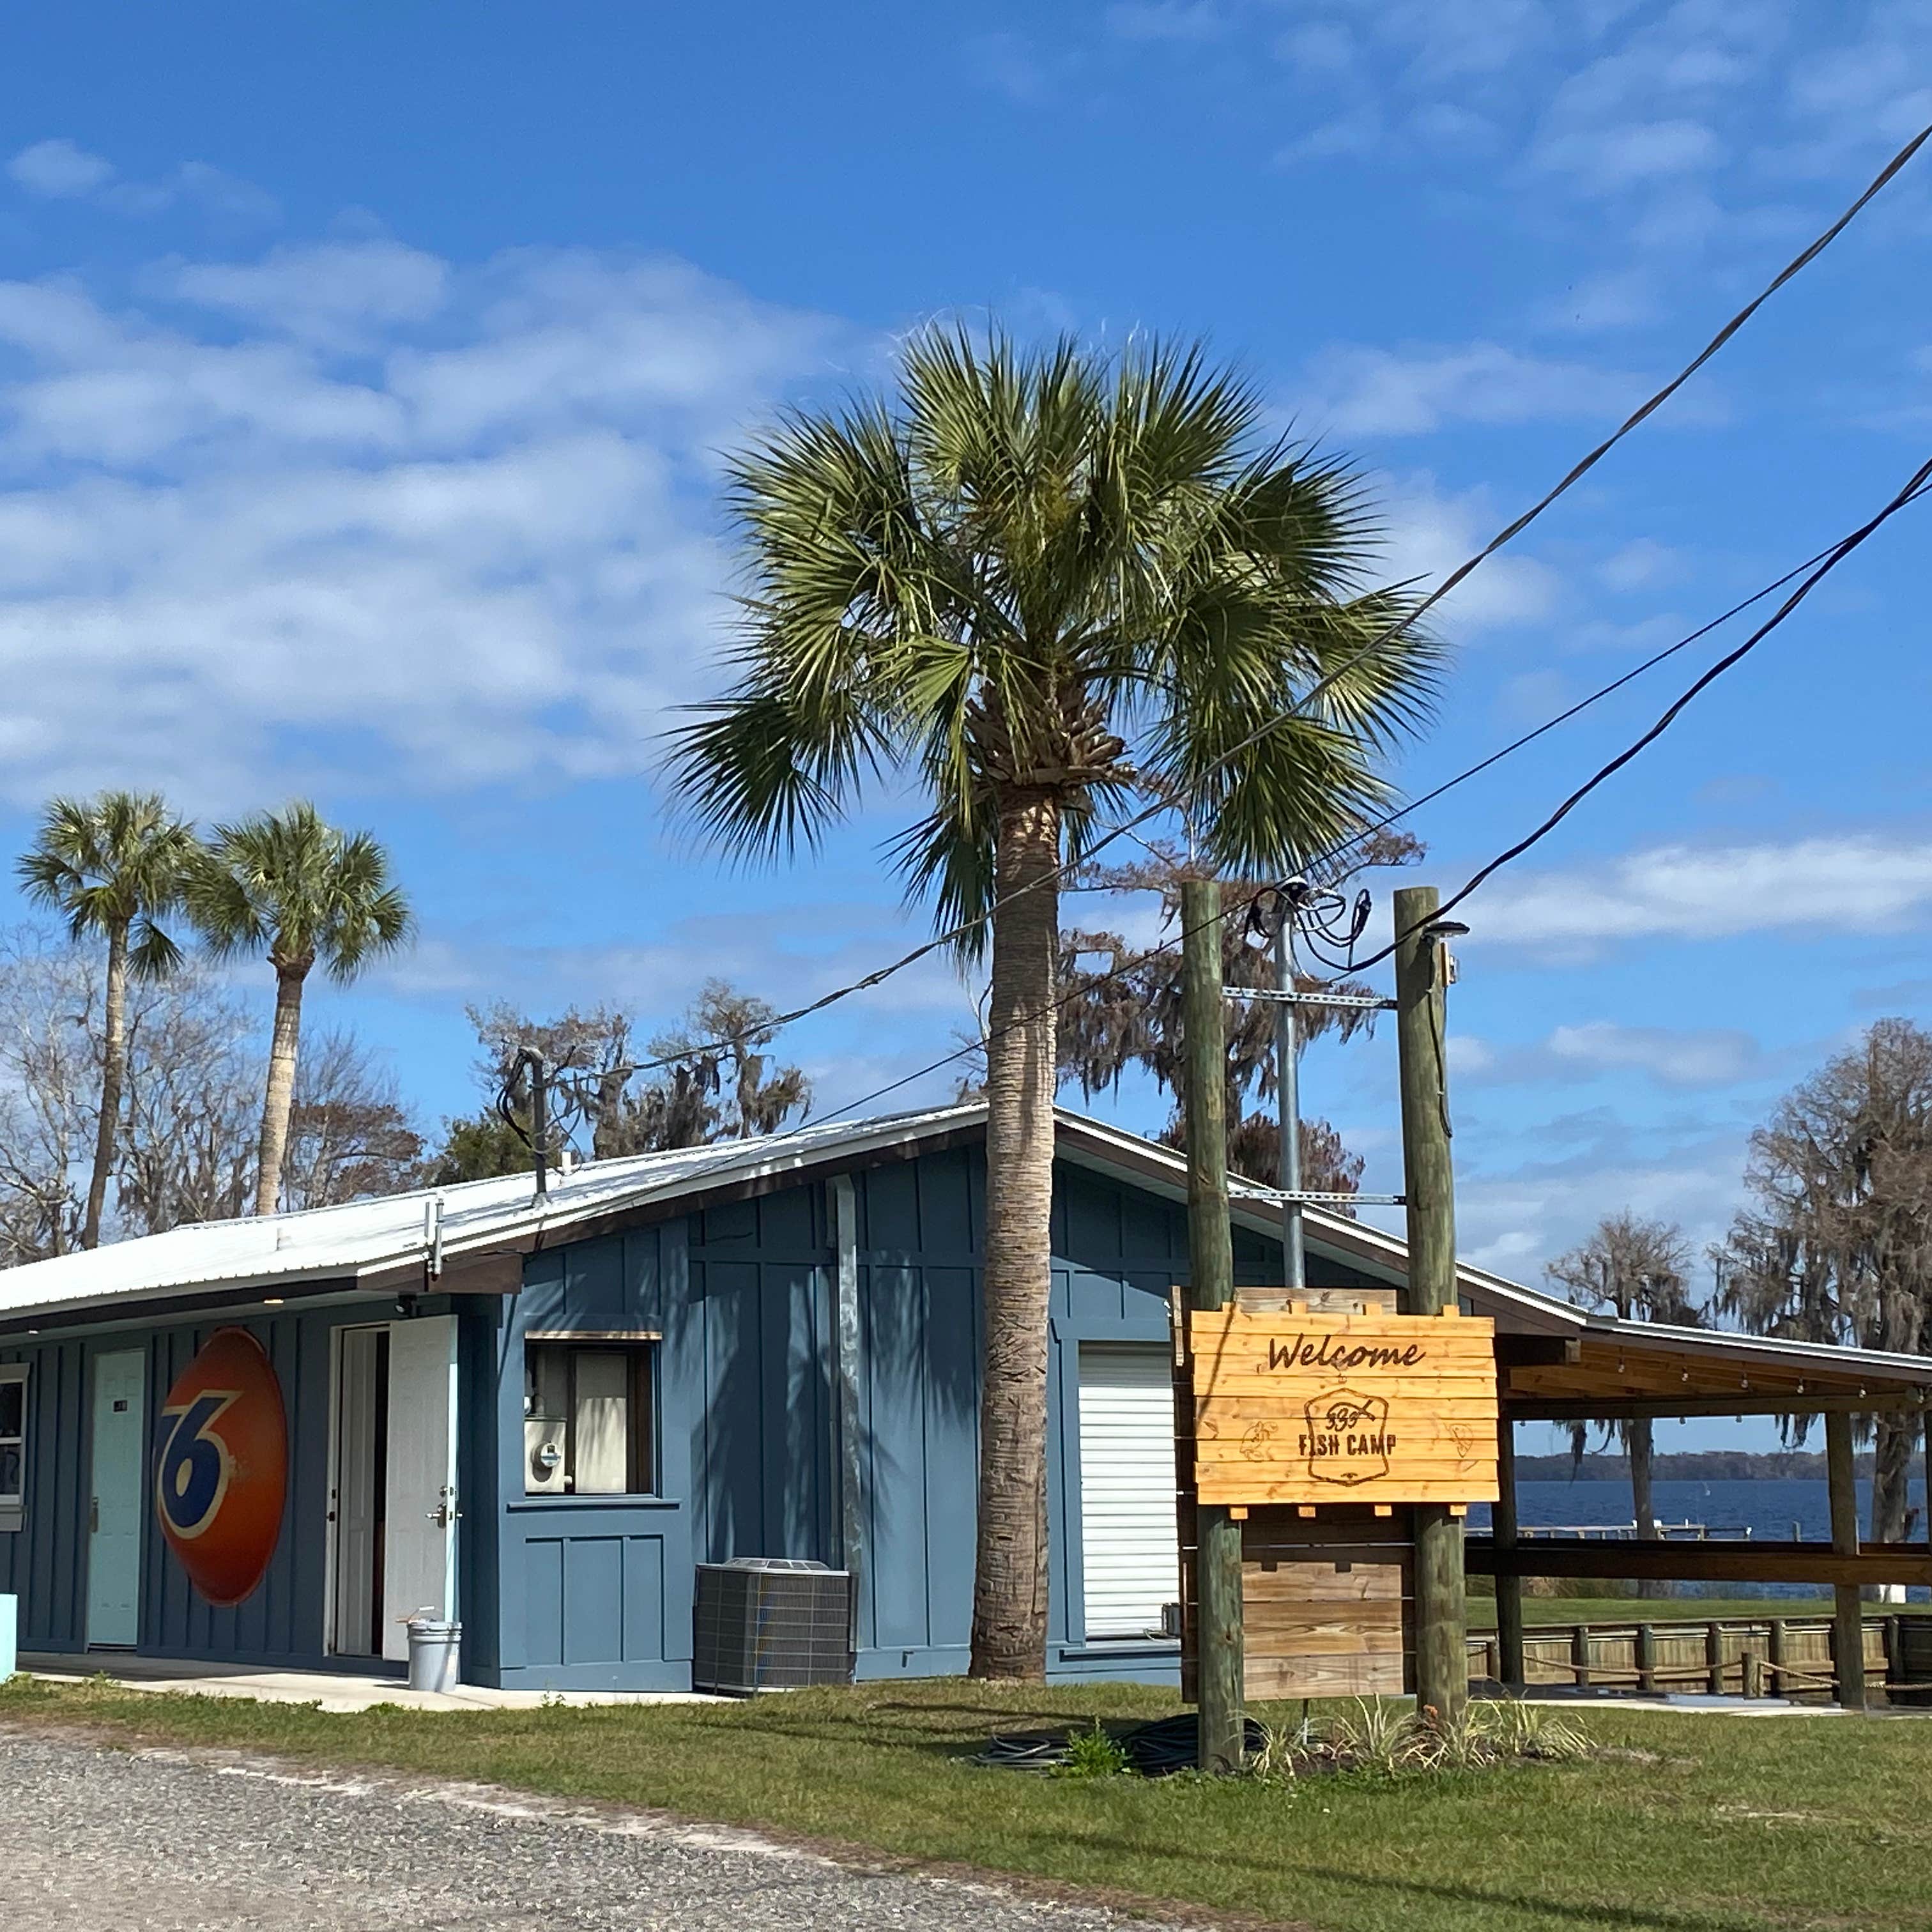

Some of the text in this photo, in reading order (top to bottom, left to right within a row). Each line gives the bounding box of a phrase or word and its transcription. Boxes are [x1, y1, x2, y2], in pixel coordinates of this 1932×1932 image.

[1269, 1333, 1427, 1370] Welcome
[1299, 1434, 1396, 1456] FISH CAMP
